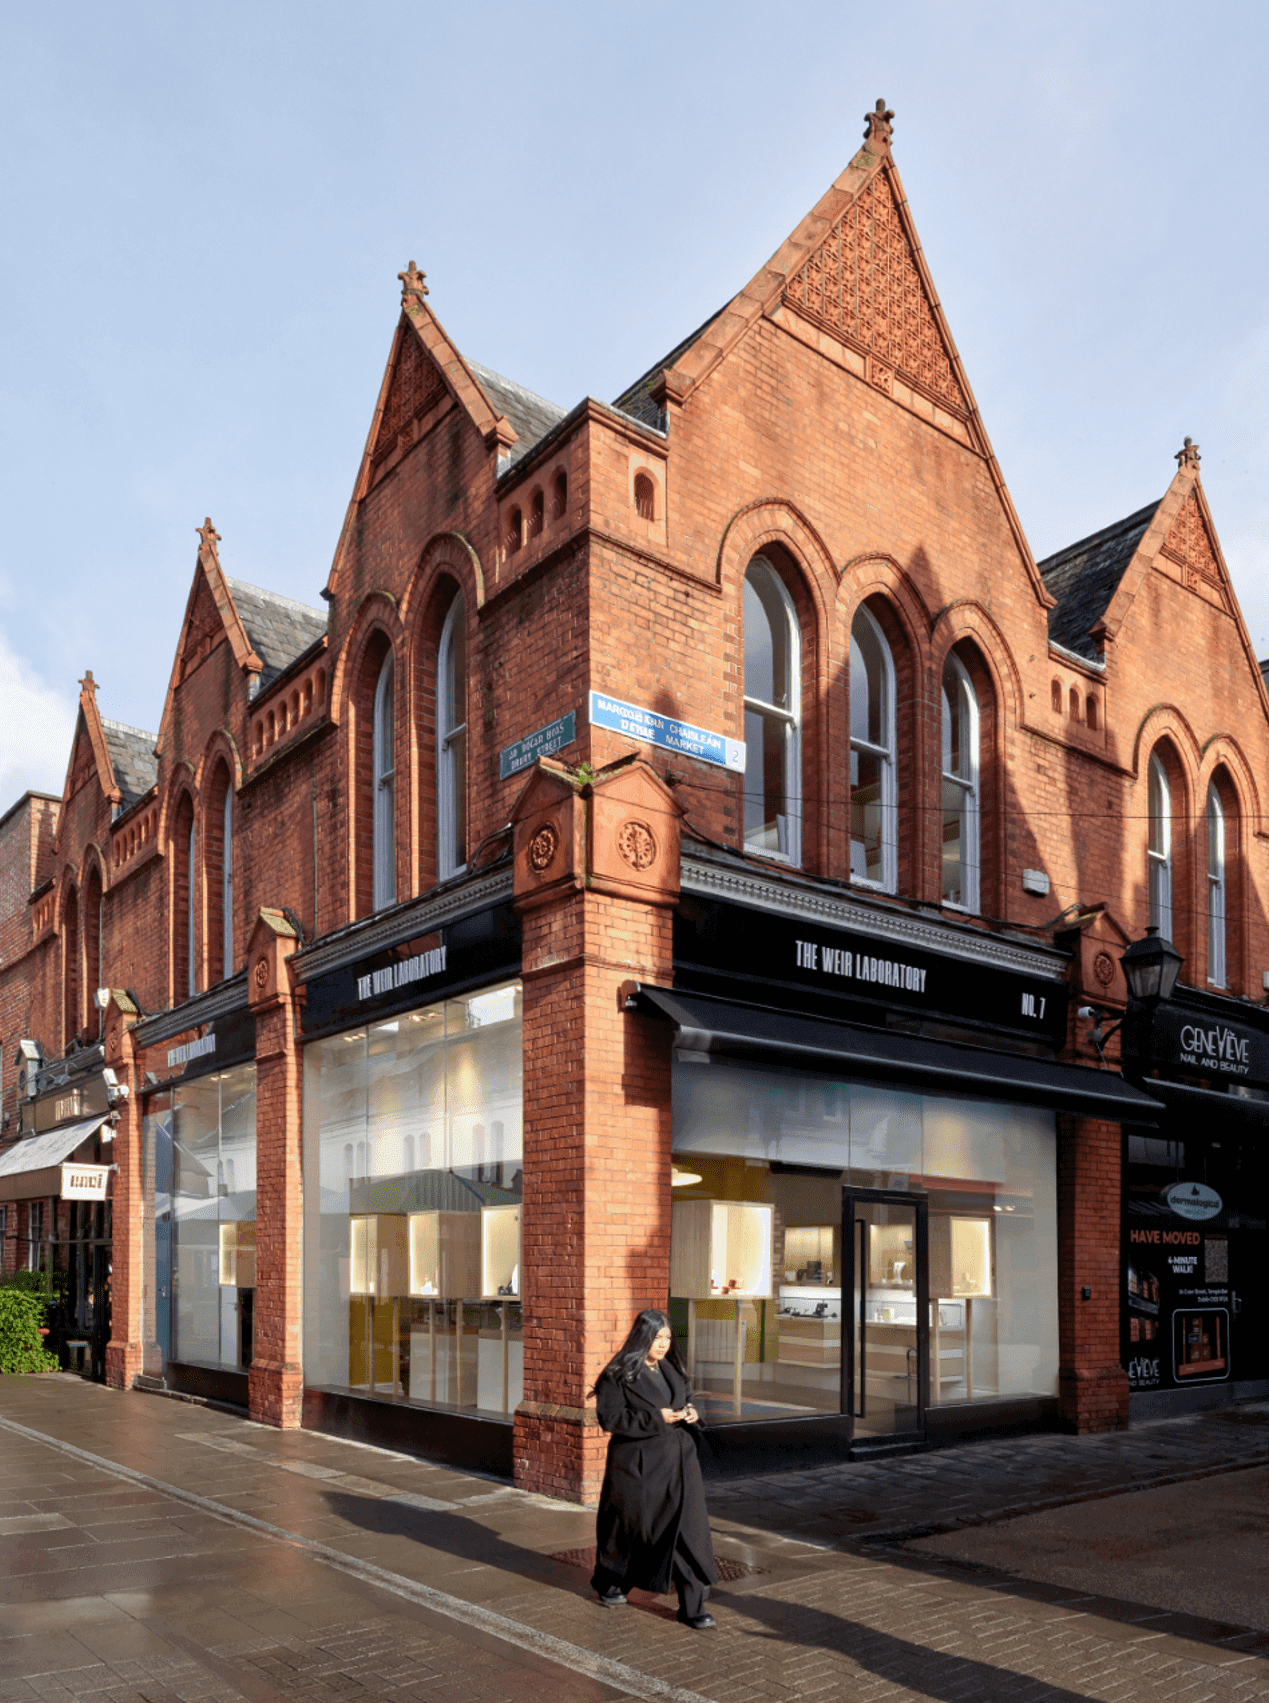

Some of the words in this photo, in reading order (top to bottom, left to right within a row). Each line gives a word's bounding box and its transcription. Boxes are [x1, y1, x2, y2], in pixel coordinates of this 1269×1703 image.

[666, 734, 704, 754] MARKET
[732, 749, 740, 762] 2
[372, 966, 394, 995] WEIR
[393, 945, 447, 988] LABORATORY
[795, 940, 818, 971] THE
[821, 946, 853, 978] WEIR
[855, 953, 927, 993] LABORATORY
[1021, 993, 1038, 1018] NO.
[1039, 997, 1046, 1020] 7
[1180, 1052, 1199, 1065] NAIL
[1200, 1057, 1218, 1069] AND
[1219, 1061, 1250, 1075] BEAUTY
[1170, 1195, 1220, 1210] dermalogica
[1130, 1229, 1161, 1244] HAVE
[1162, 1230, 1201, 1246] MOVED
